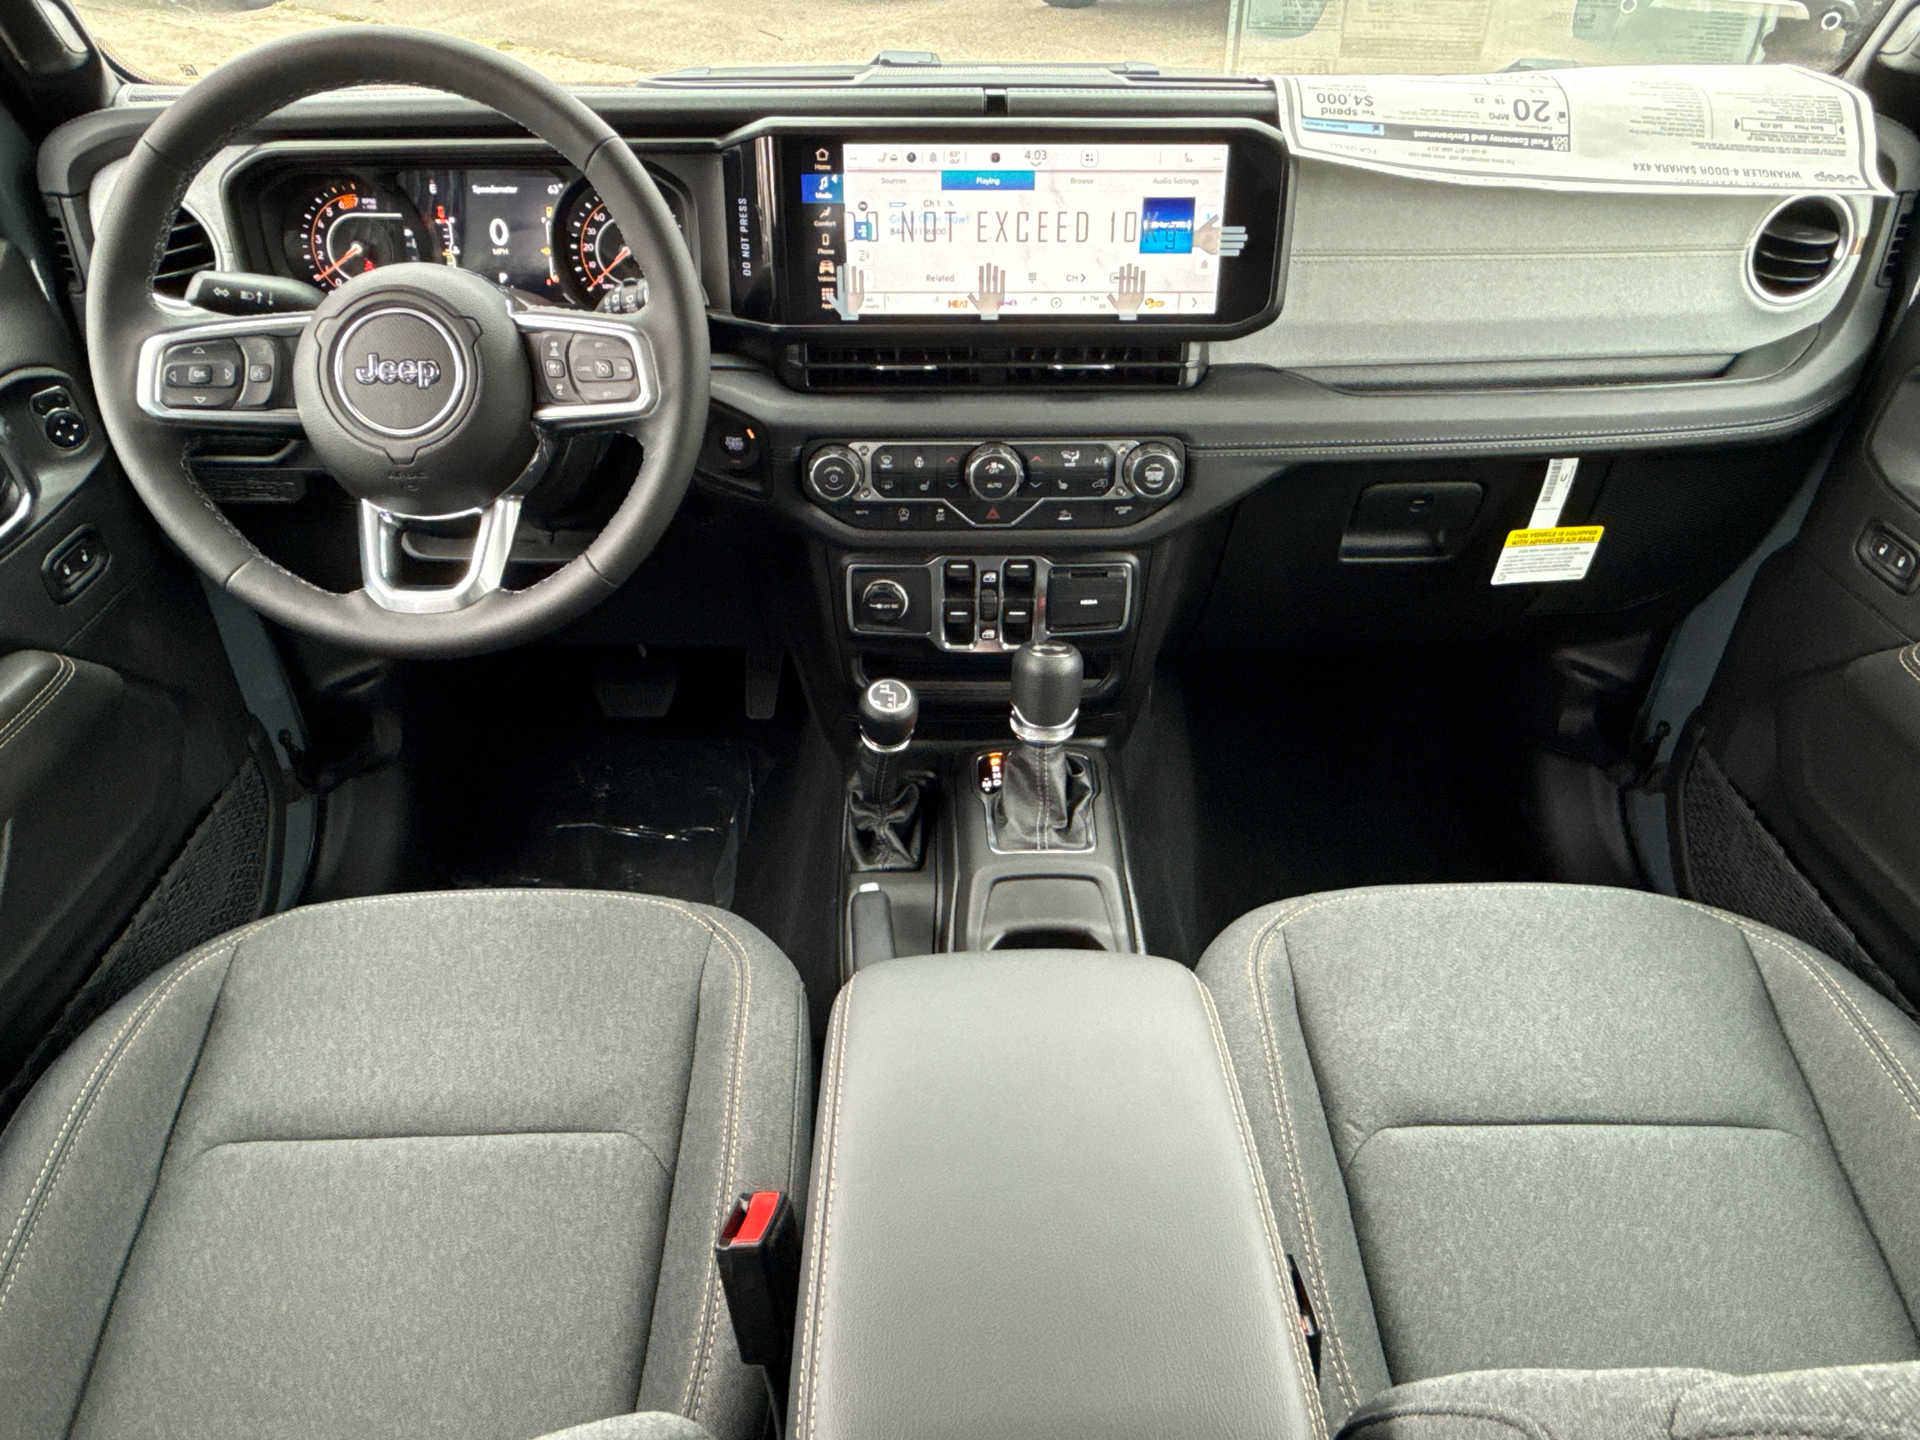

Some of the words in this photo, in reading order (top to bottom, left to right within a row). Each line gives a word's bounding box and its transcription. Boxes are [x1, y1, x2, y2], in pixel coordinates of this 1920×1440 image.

[1316, 93, 1374, 107] $4,000
[1321, 106, 1358, 117] spend
[1512, 98, 1551, 123] 20
[1488, 112, 1510, 121] MPG
[1413, 130, 1470, 143] Environment
[1470, 133, 1488, 145] and
[1489, 133, 1529, 146] Economy
[1552, 135, 1568, 144] DOT
[1530, 138, 1549, 148] Fuel
[1023, 150, 1047, 160] 4:03
[1633, 162, 1652, 173] 4X4
[1654, 163, 1697, 175] SAHARA
[1699, 166, 1740, 176] 4-DOOR
[1742, 168, 1802, 179] WRANGLER
[1814, 171, 1859, 185] Jeep
[881, 177, 906, 185] Sources
[976, 177, 1000, 186] Playing
[1173, 178, 1199, 186] Settings
[472, 185, 518, 195] Speedometer
[325, 207, 334, 217] 5
[593, 212, 605, 222] 40
[737, 197, 749, 233] PRESS
[489, 218, 509, 246] 0
[587, 227, 596, 236] 30
[901, 211, 957, 242] NOT
[977, 211, 1089, 243] EXCEED
[1110, 211, 1137, 243] 10
[315, 234, 322, 244] 3
[492, 248, 509, 256] MPH
[583, 243, 594, 252] 20
[740, 236, 750, 258] NOT
[317, 250, 325, 260] 2
[588, 261, 596, 269] 10
[742, 261, 752, 276] DO
[926, 274, 955, 283] Related
[1066, 274, 1079, 282] CH
[948, 300, 969, 309] HEAT
[193, 370, 206, 378] OK
[355, 352, 441, 389] Jeep
[1094, 457, 1108, 465] A/C
[1530, 531, 1556, 539] VEHICLE
[1565, 529, 1598, 537] EQUIPPED
[1529, 537, 1565, 545] ADVANCED
